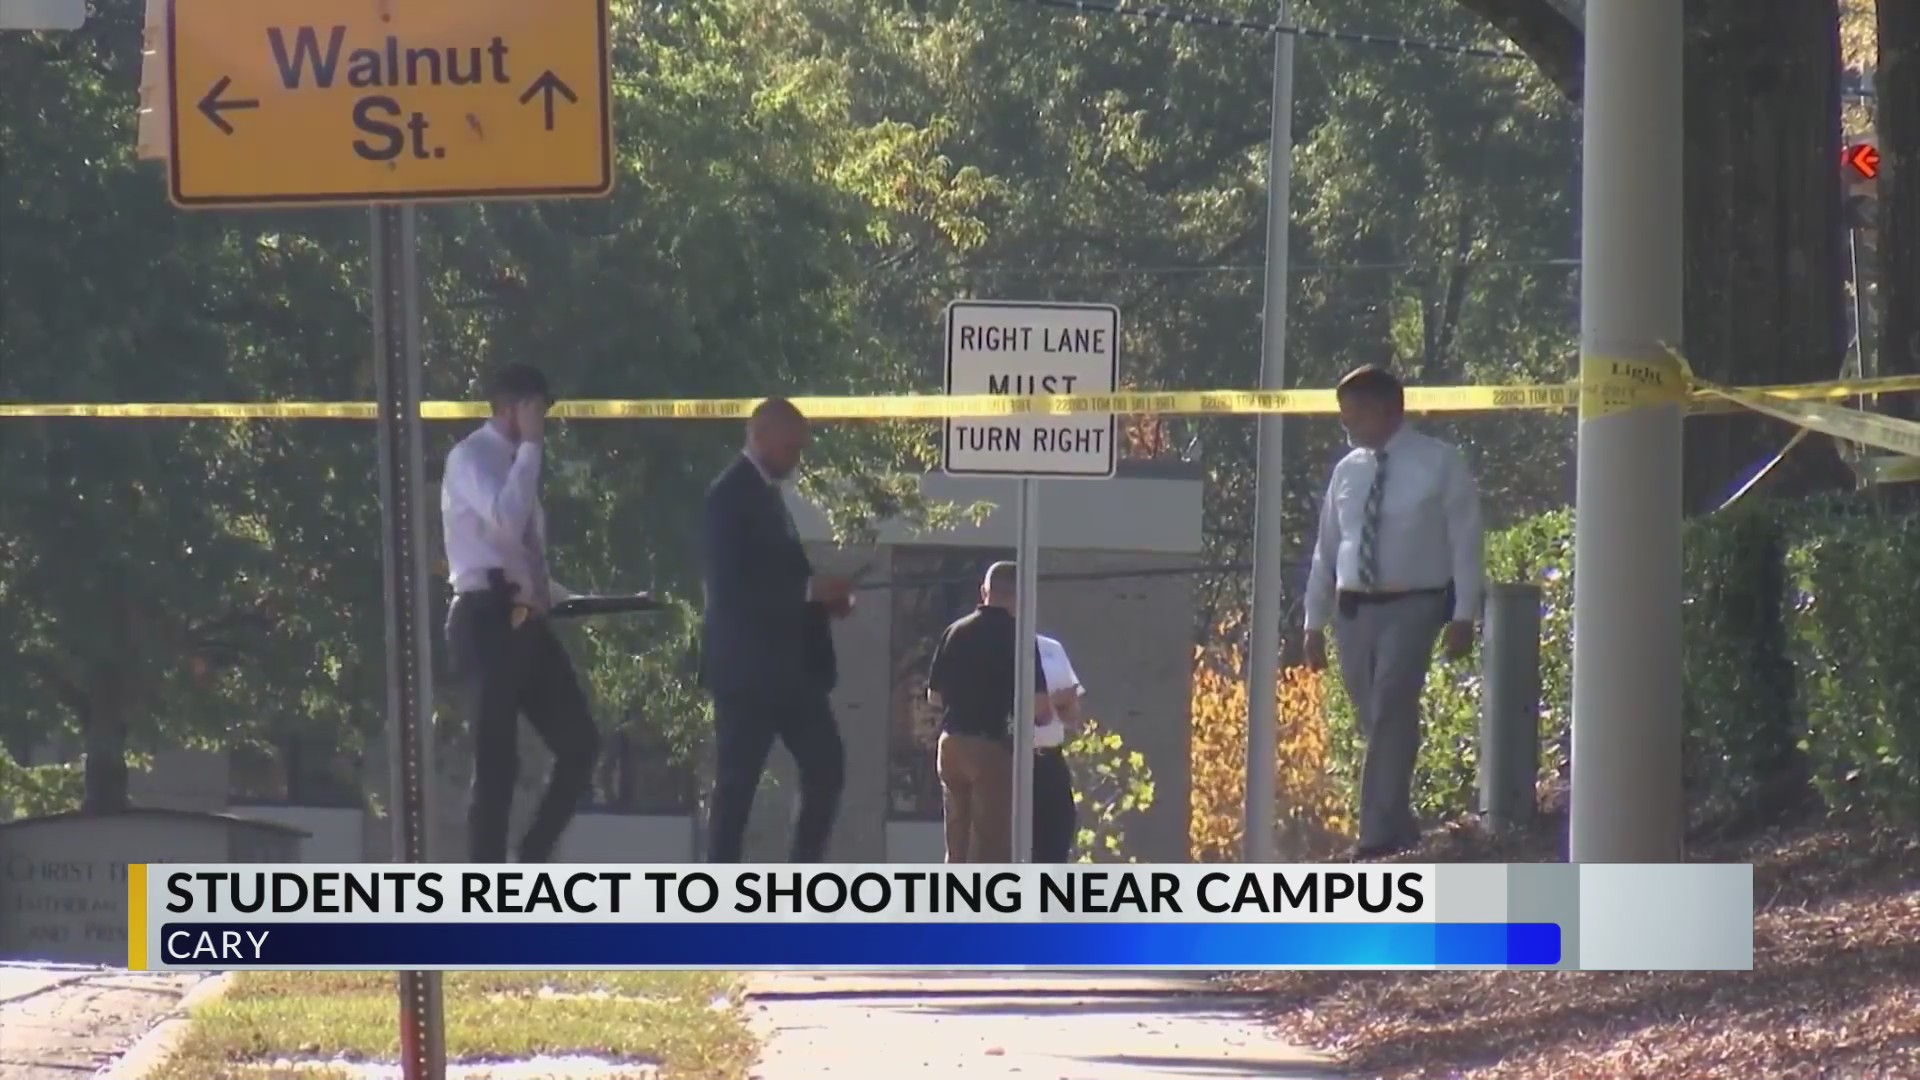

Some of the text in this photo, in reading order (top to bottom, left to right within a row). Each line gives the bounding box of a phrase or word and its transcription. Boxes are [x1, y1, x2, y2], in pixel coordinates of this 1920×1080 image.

[267, 25, 510, 89] Walnut
[352, 96, 446, 161] St.
[961, 326, 1105, 354] RIGHT LANE
[989, 374, 1077, 395] MUST
[957, 426, 1105, 453] TURN RIGHT
